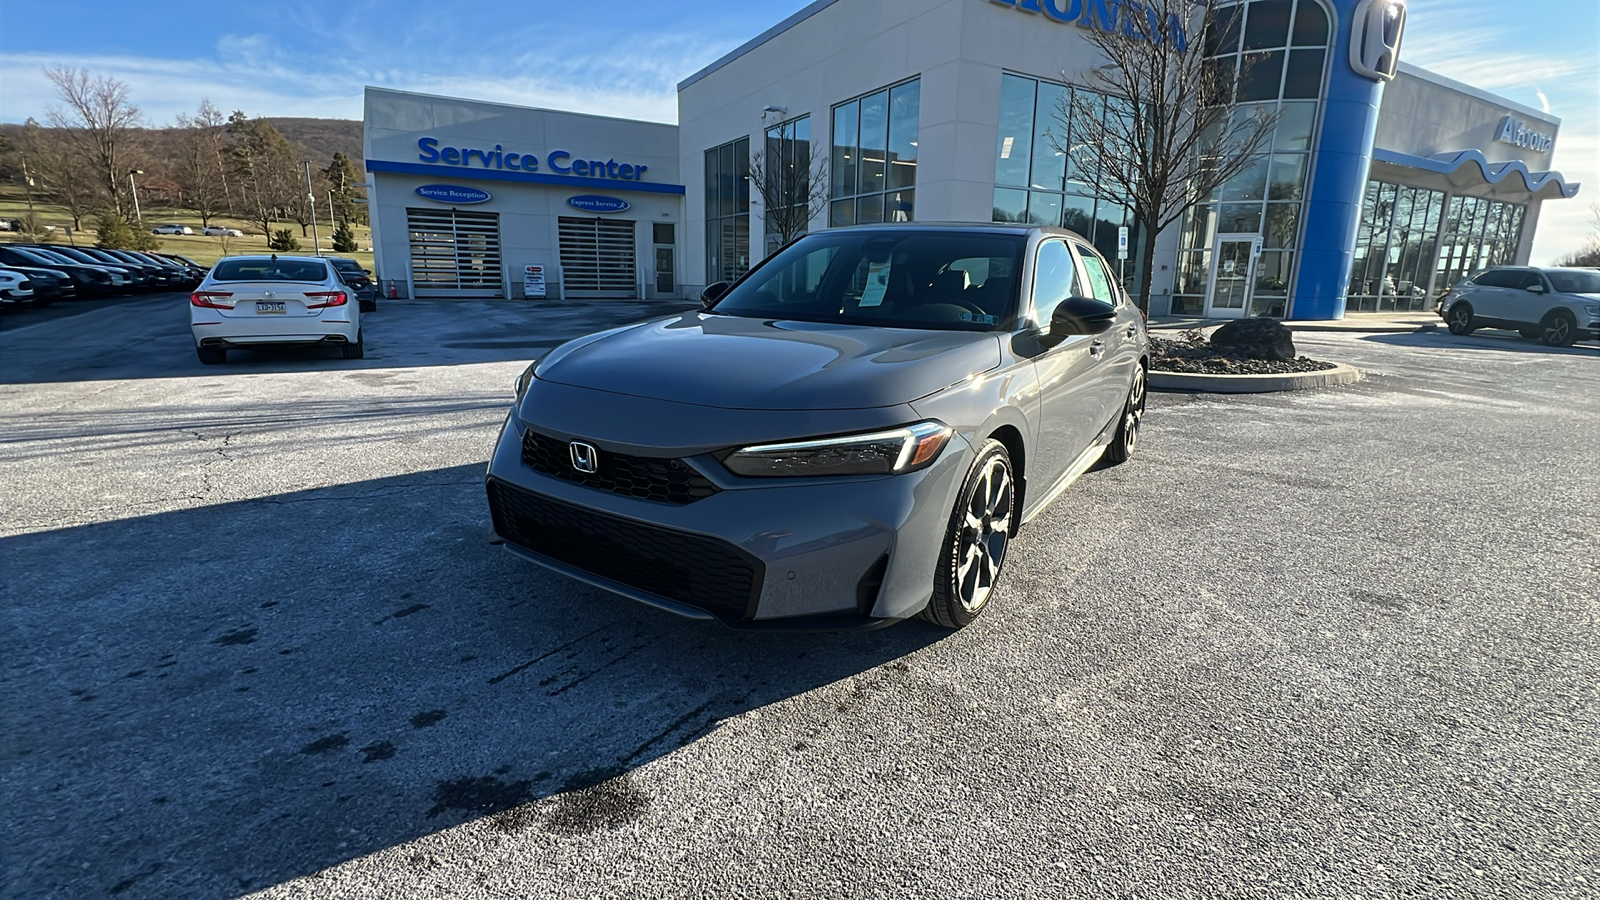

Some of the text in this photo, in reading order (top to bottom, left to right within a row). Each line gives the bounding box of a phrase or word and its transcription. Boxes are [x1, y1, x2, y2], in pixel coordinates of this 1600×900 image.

[988, 0, 1188, 52] ONDA
[1497, 114, 1553, 154] Altoona
[418, 137, 648, 180] Service Center
[420, 188, 486, 199] Service Reception
